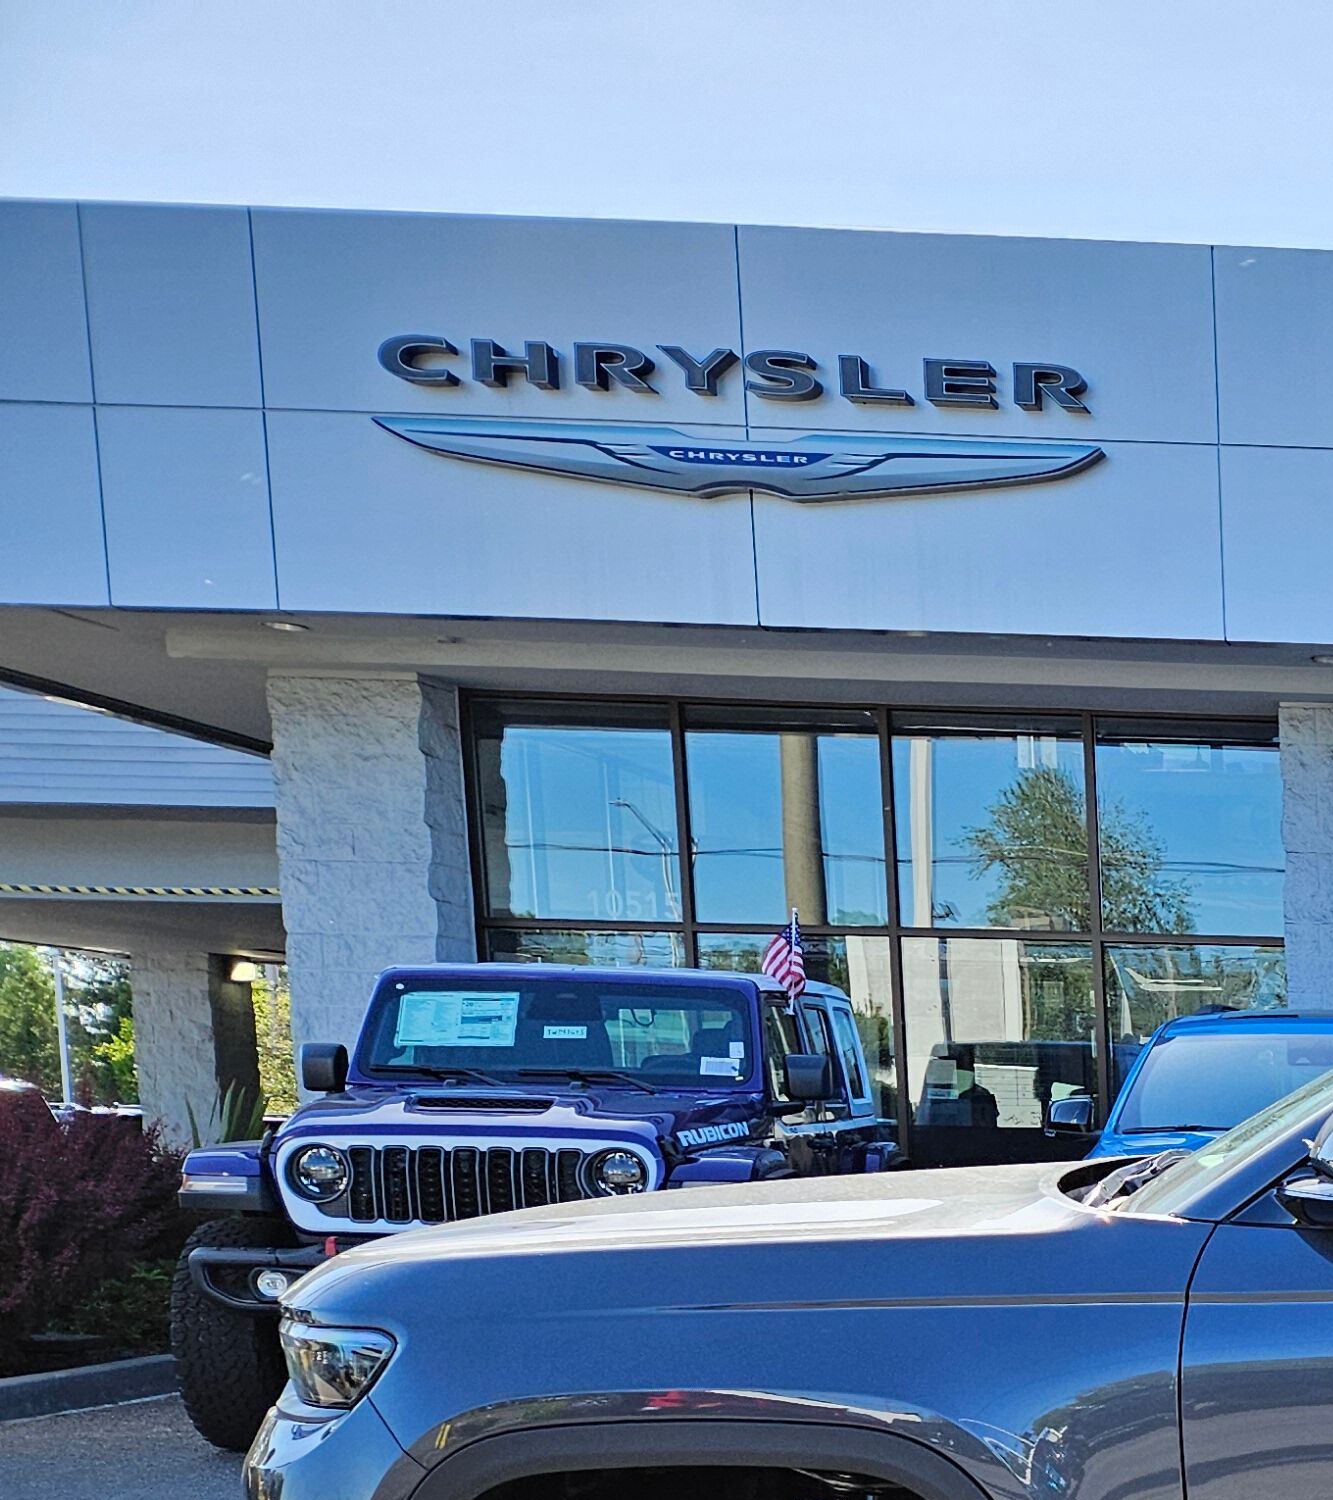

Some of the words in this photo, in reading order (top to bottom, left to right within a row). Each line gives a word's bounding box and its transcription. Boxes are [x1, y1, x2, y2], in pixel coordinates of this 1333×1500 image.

[377, 333, 1092, 414] CHRYSLER
[669, 450, 808, 464] CHRYSLER
[676, 1121, 750, 1147] RUBICON
